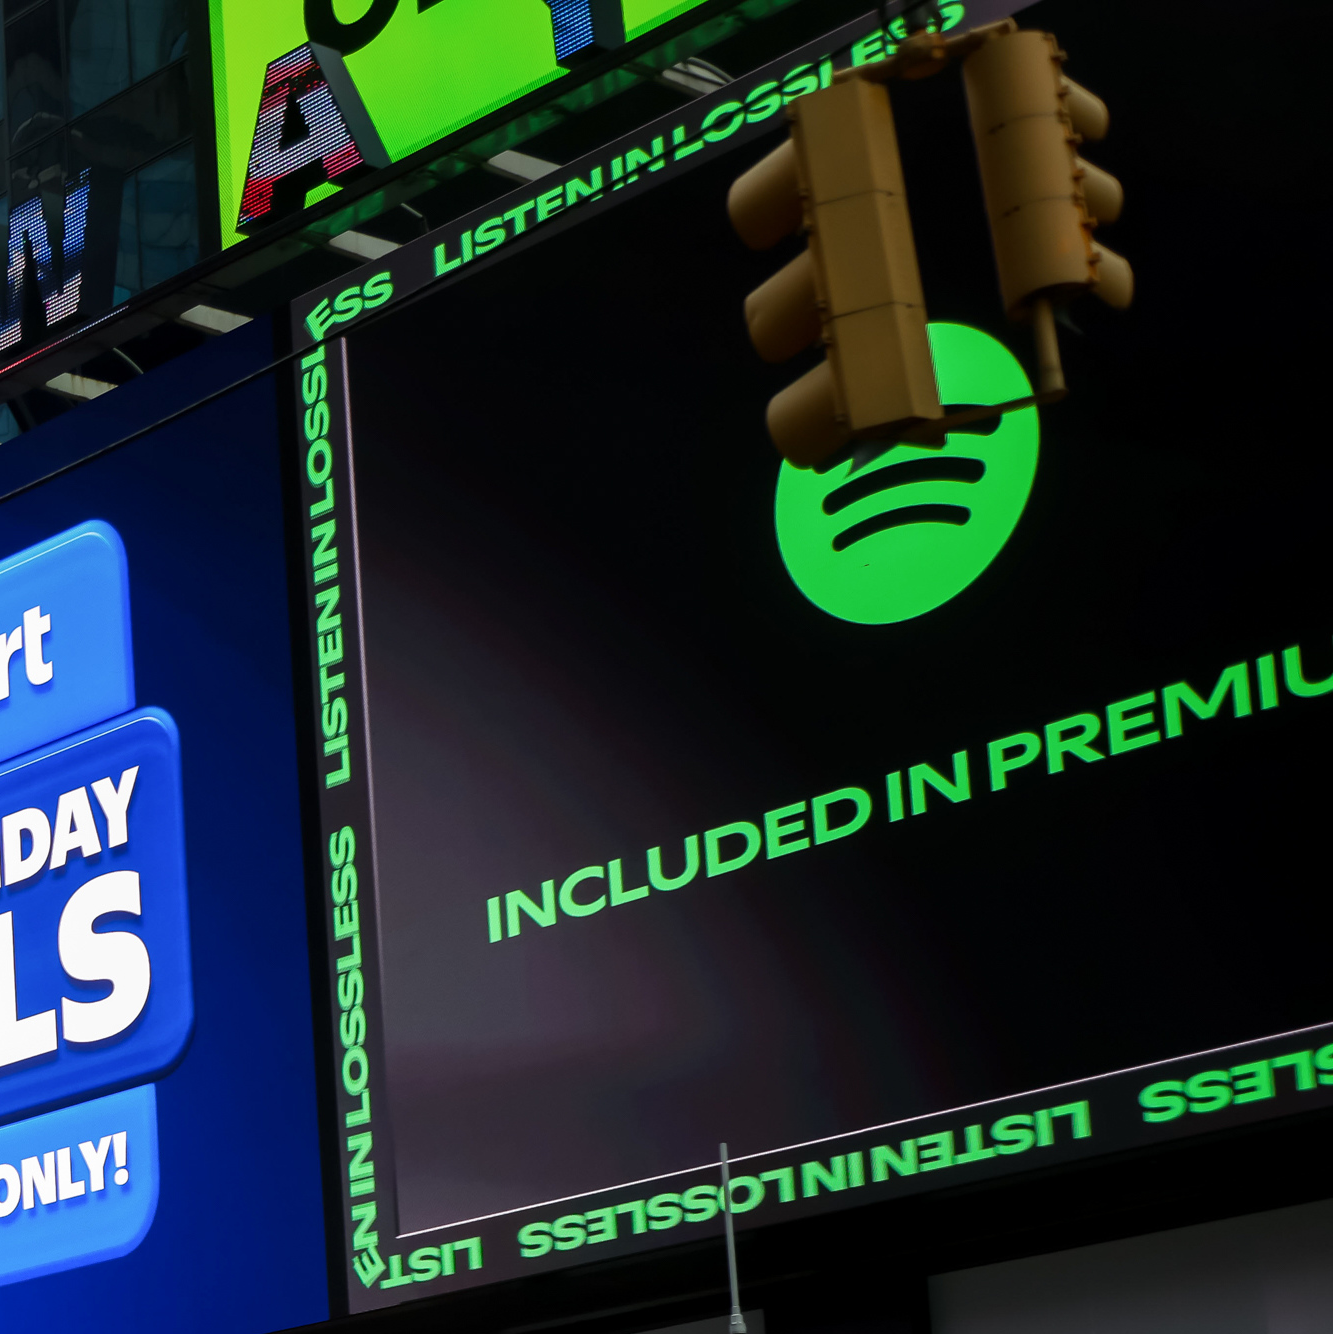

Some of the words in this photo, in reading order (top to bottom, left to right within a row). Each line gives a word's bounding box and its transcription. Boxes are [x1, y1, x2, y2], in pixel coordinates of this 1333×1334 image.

[433, 172, 603, 277] LISTEN
[610, 136, 665, 193] IN
[310, 518, 339, 585] IN
[314, 584, 352, 790] LISTEN
[487, 786, 873, 944] INCLUDED
[886, 749, 972, 824] IN
[330, 825, 372, 1128] LOSSLESS
[347, 1131, 375, 1198] IN
[802, 1151, 864, 1197] IN
[870, 1099, 1093, 1185] LISTEN
[517, 1166, 795, 1259] LOSSLESS
